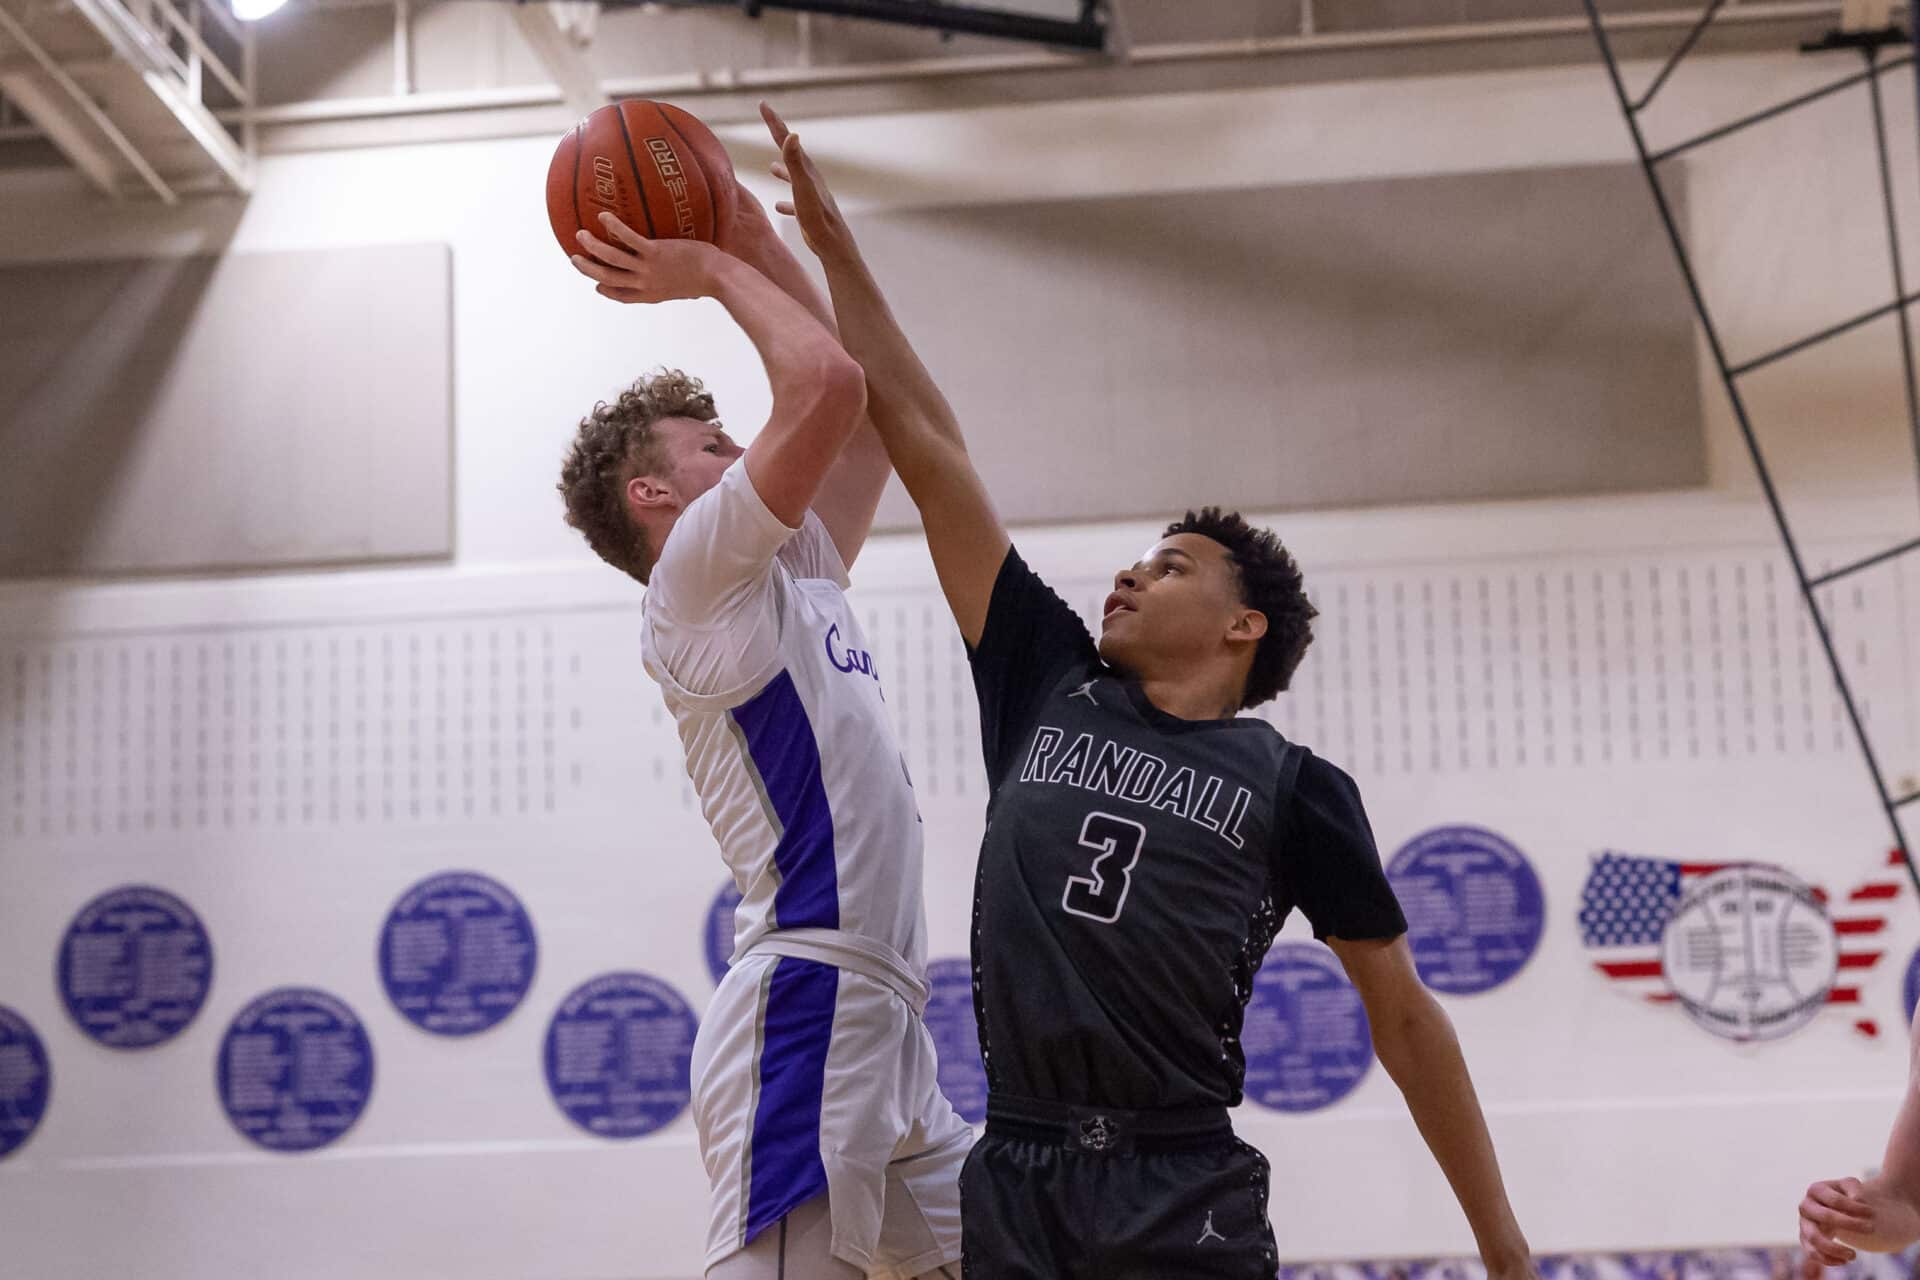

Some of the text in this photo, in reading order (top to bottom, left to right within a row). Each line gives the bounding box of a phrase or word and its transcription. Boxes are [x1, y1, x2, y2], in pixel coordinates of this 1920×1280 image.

[649, 139, 681, 176] PRO
[825, 622, 885, 703] Can
[1020, 726, 1252, 849] RANDALL
[1062, 811, 1147, 925] 3
